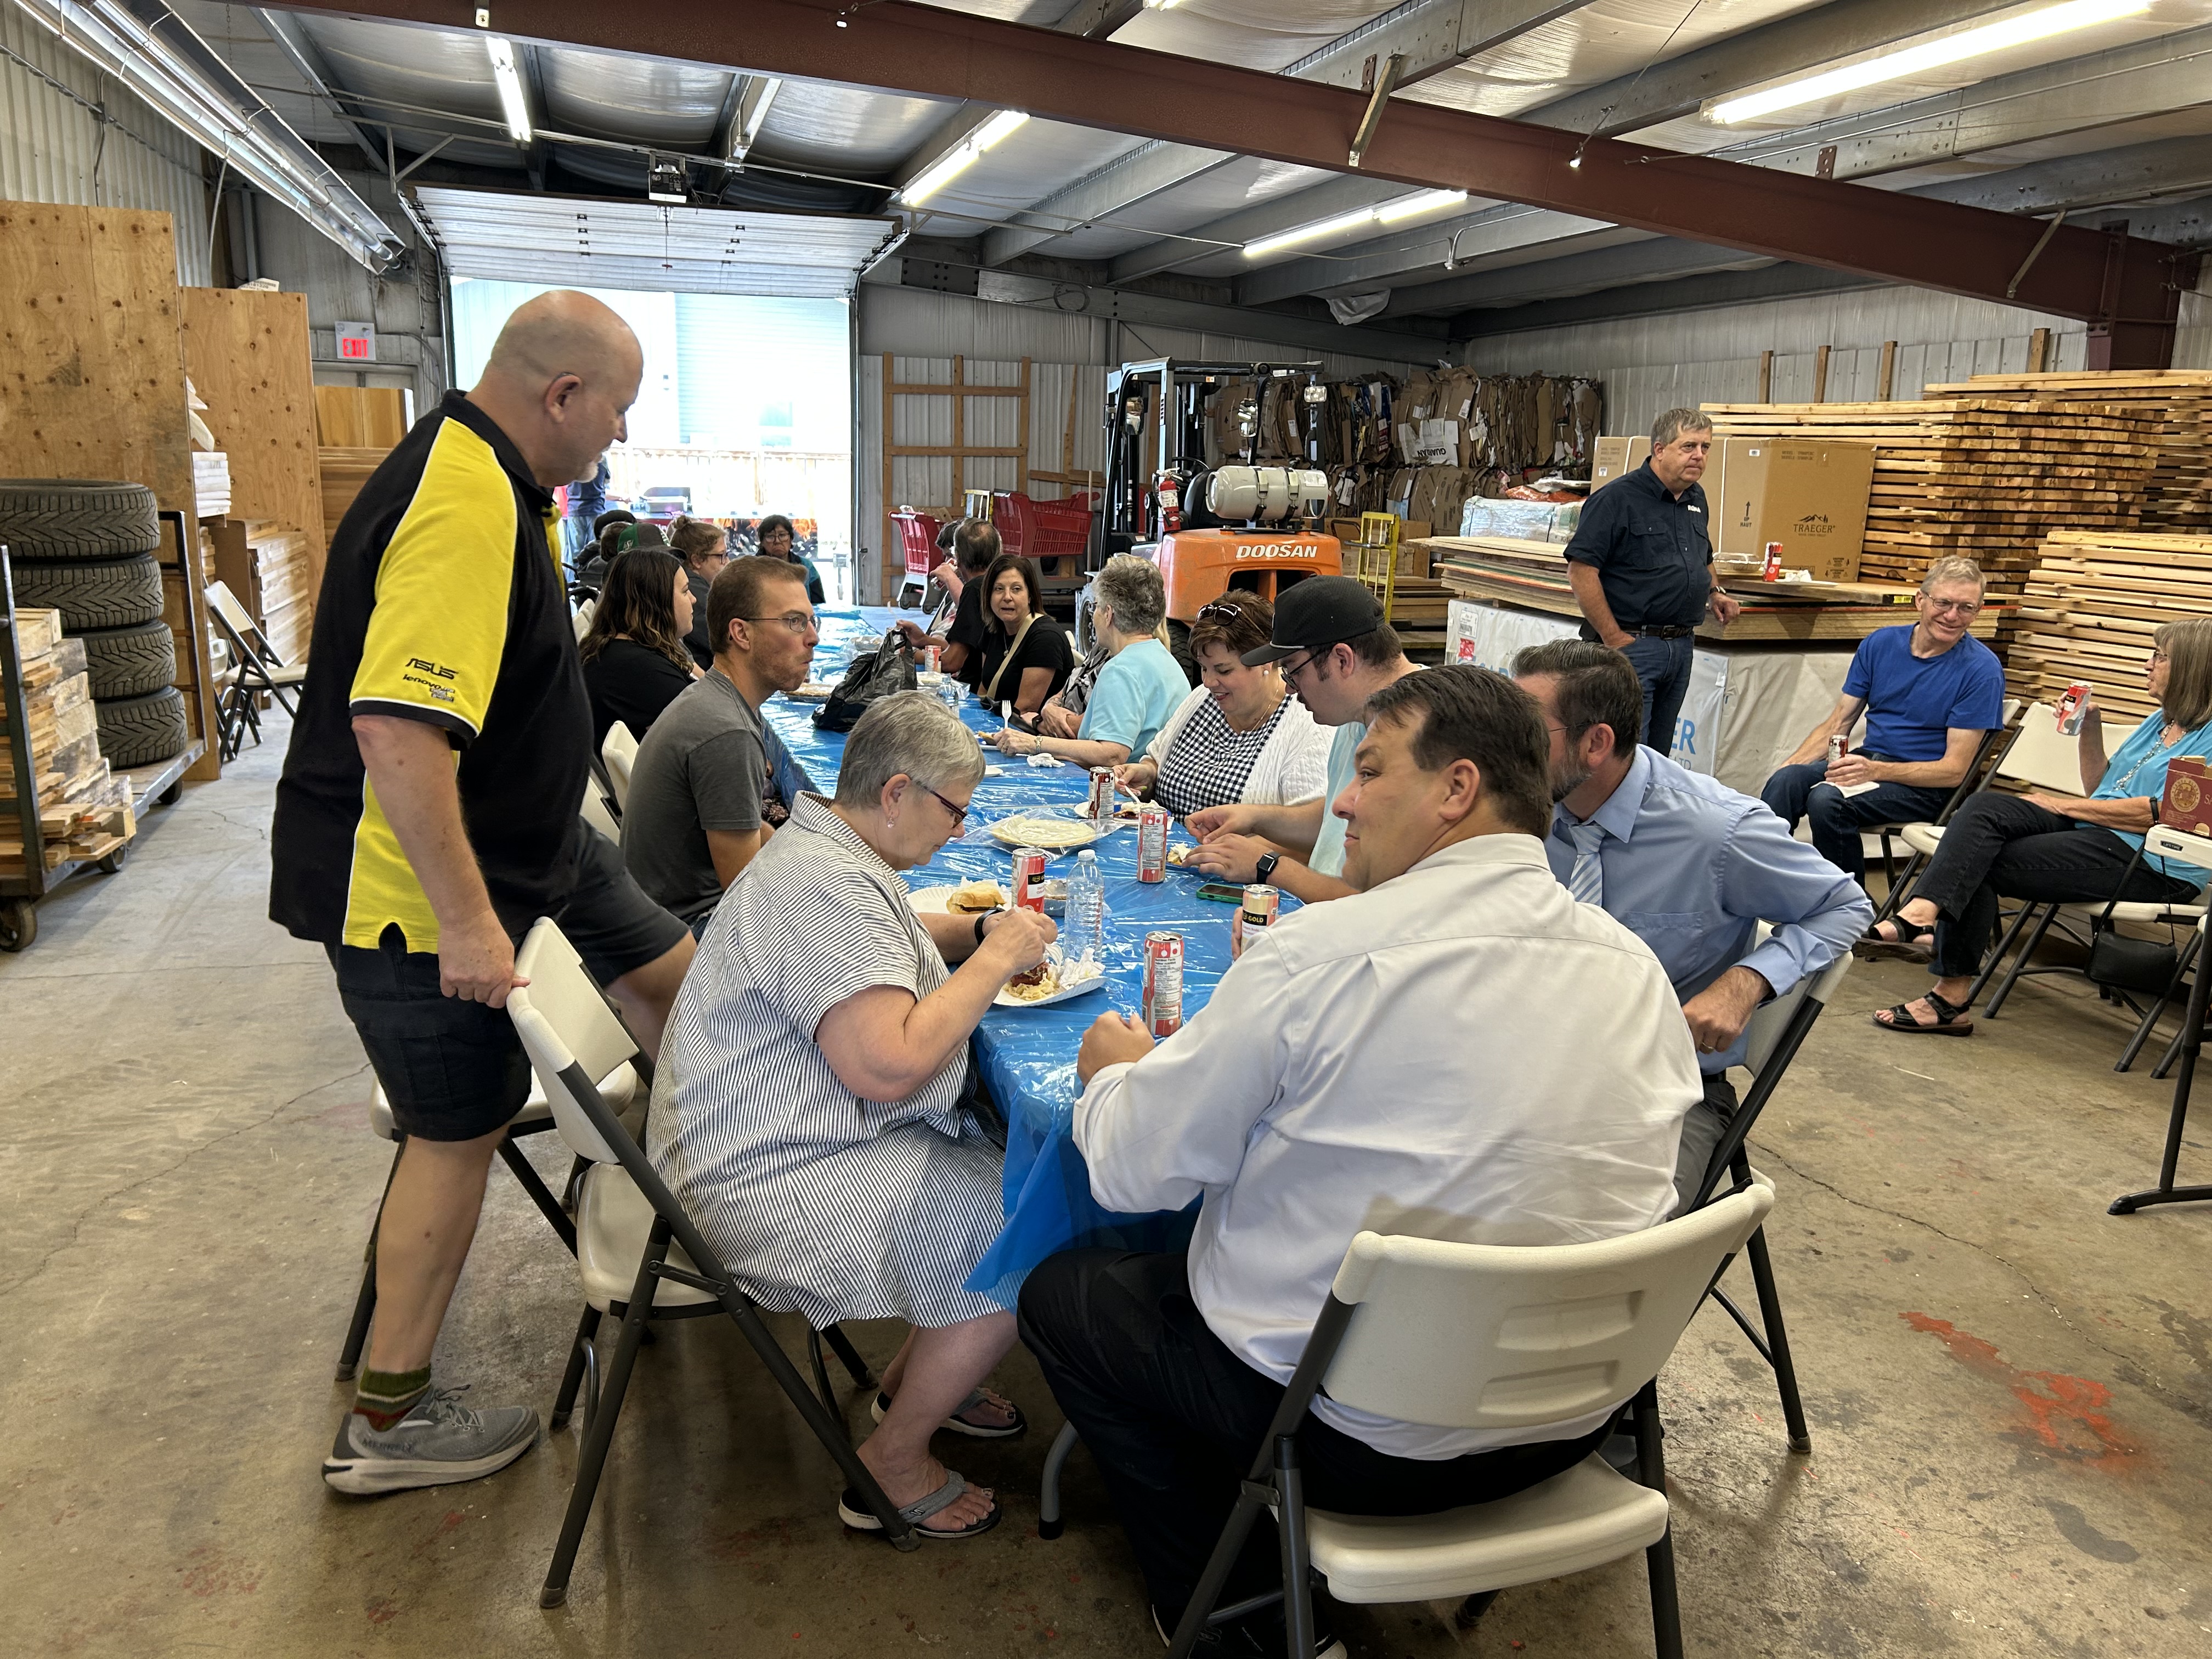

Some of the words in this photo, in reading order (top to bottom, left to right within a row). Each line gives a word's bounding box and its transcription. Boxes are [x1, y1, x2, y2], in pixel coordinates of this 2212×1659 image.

[342, 337, 369, 358] EXIT
[1793, 524, 1833, 533] TRAEGER
[1235, 544, 1318, 558] DOOSAN
[405, 658, 459, 680] ASUS
[403, 674, 442, 690] lenovo
